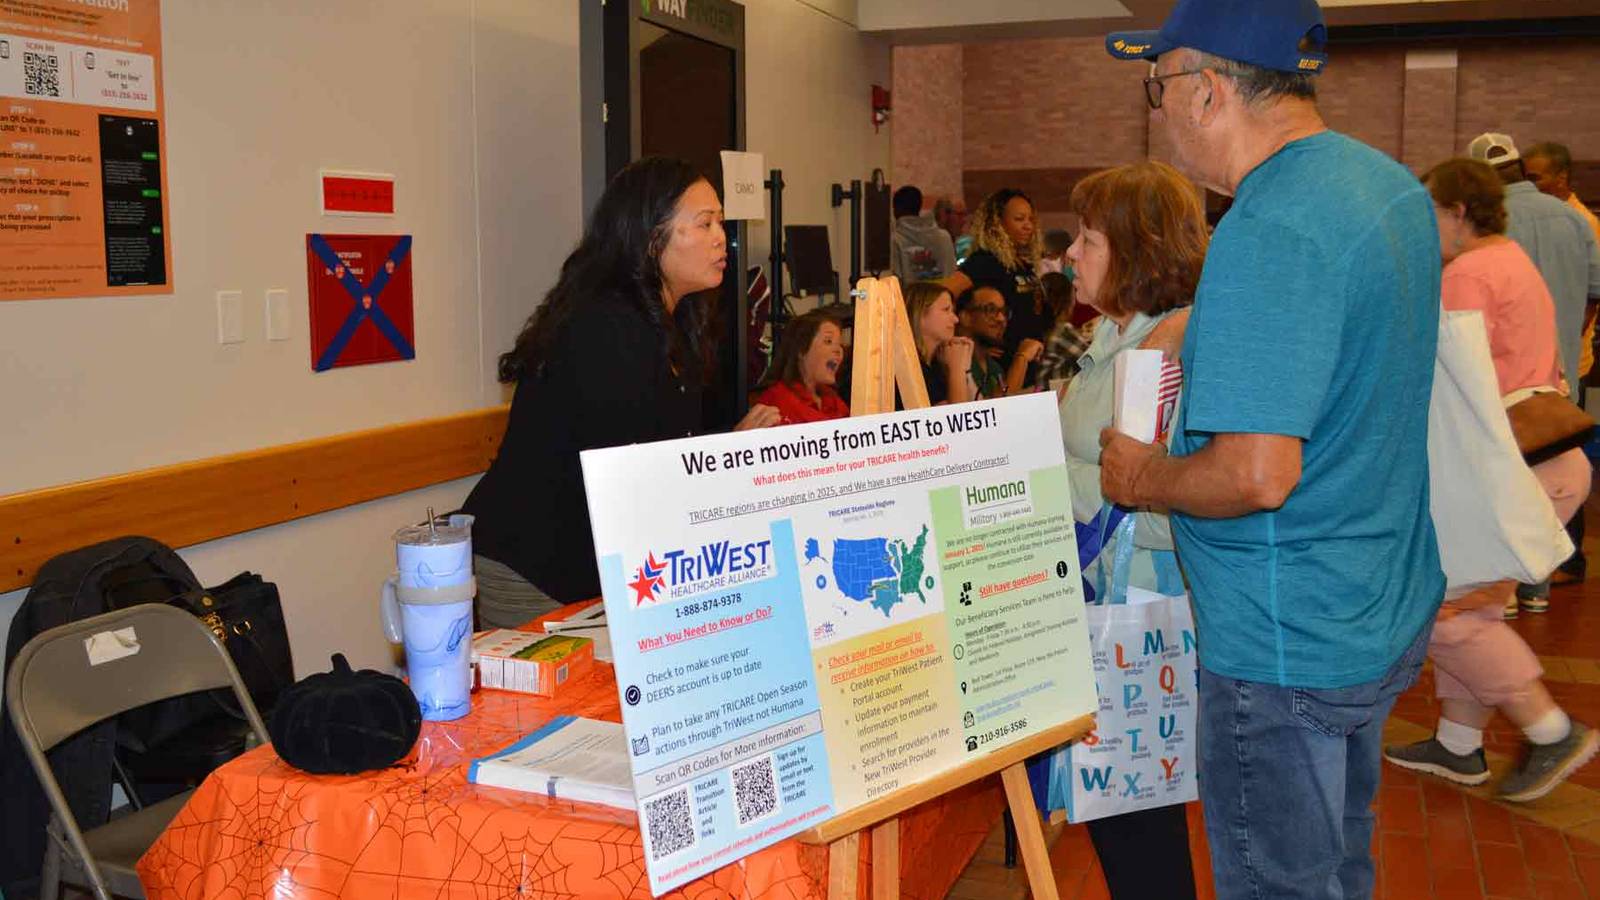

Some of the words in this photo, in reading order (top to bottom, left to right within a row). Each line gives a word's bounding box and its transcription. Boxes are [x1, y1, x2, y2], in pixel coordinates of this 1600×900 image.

[681, 450, 717, 475] We
[723, 449, 755, 469] are
[760, 435, 830, 463] moving
[833, 430, 877, 451] from
[880, 420, 920, 444] EAST
[925, 419, 943, 437] to
[946, 408, 997, 433] WEST!
[753, 474, 776, 486] What
[777, 470, 796, 483] does
[797, 467, 812, 479] this
[813, 465, 835, 476] mean
[836, 462, 847, 472] for
[848, 460, 865, 471] your
[867, 453, 897, 467] TRICARE
[898, 448, 921, 461] health
[921, 443, 950, 458] benefit?
[689, 506, 725, 522] TRICARE
[726, 500, 756, 516] regions
[757, 498, 771, 509] are
[771, 491, 806, 507] changing
[807, 489, 815, 499] in
[817, 485, 839, 498] 2025,
[838, 480, 853, 493] and
[854, 480, 867, 491] We
[867, 476, 885, 488] have
[886, 478, 892, 486] a
[892, 475, 907, 485] new
[908, 467, 945, 482] HealthCare
[946, 461, 973, 475] Delivery
[973, 453, 1009, 469] Contractor!
[966, 480, 1026, 506] Humana
[970, 512, 997, 527] Military
[670, 576, 726, 598] HEALTHCARE
[980, 583, 993, 597] Still
[994, 581, 1011, 593] have
[1012, 569, 1049, 588] questions?
[676, 592, 742, 618] 1-888-874-9378
[967, 608, 999, 623] Beneficiary
[999, 601, 1022, 613] Services
[1022, 596, 1037, 607] Team
[1043, 591, 1055, 600] here
[637, 637, 663, 650] What
[664, 630, 682, 643] You
[683, 623, 707, 638] Need
[708, 621, 718, 631] to
[719, 614, 743, 628] Know
[744, 611, 754, 621] or
[755, 606, 772, 619] Do?
[646, 670, 672, 685] Check
[674, 666, 685, 677] to
[686, 658, 710, 673] make
[711, 653, 729, 666] sure
[730, 647, 751, 662] your
[828, 655, 850, 667] Check
[851, 649, 868, 661] your
[869, 644, 885, 656] mail
[885, 641, 894, 650] or
[895, 634, 914, 648] email
[646, 687, 675, 704] DEERS
[676, 675, 710, 694] account
[712, 672, 719, 683] is
[720, 669, 732, 683] up
[733, 666, 742, 676] to
[744, 659, 763, 673] date
[831, 670, 857, 683] receive
[857, 656, 899, 676] information
[850, 677, 874, 692] Create
[874, 673, 892, 686] your
[892, 662, 918, 679] TriWest
[919, 655, 944, 672] Patient
[651, 723, 672, 738] Plan
[673, 720, 683, 731] to
[684, 714, 704, 728] take
[704, 708, 720, 721] any
[720, 694, 755, 716] TRICARE
[756, 687, 779, 705] Open
[779, 679, 808, 696] Season
[853, 691, 875, 708] Portal
[875, 683, 903, 700] account
[855, 706, 881, 723] Update
[882, 701, 898, 714] your
[899, 689, 930, 707] payment
[655, 738, 687, 756] actions
[688, 723, 722, 744] through
[723, 712, 754, 731] TriWest
[755, 709, 770, 721] not
[771, 697, 804, 714] Humana
[857, 715, 899, 737] information
[899, 712, 908, 722] to
[908, 702, 938, 719] maintain
[980, 717, 1028, 745] 210-916-3586
[859, 731, 899, 753] enrollment
[862, 751, 887, 768] Search
[887, 747, 897, 759] for
[898, 734, 931, 754] providers
[938, 726, 950, 738] the
[655, 771, 677, 787] Scan
[677, 762, 692, 777] QR
[693, 753, 720, 772] Codes
[720, 748, 733, 761] for
[734, 741, 757, 757] More
[864, 769, 881, 782] New
[882, 758, 908, 775] TriWest
[909, 747, 937, 766] Provider
[695, 778, 719, 793] TRICARE
[696, 788, 725, 804] Transition
[866, 778, 899, 798] Directory
